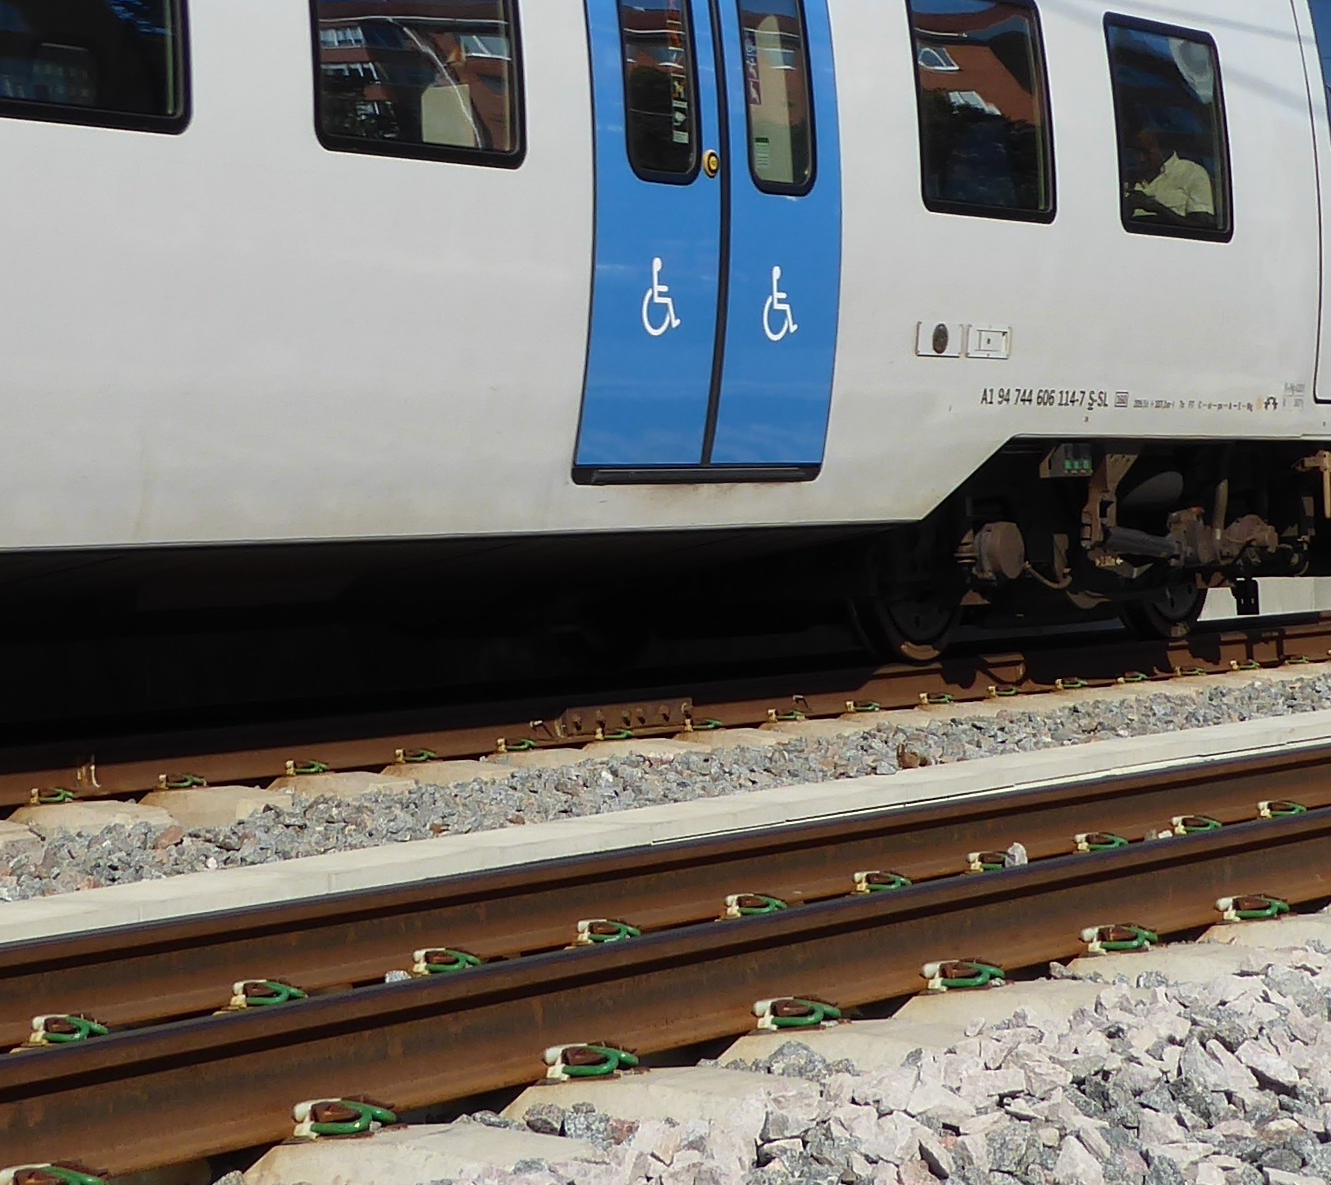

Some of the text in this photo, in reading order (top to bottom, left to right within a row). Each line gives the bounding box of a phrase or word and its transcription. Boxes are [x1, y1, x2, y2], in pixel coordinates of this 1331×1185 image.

[980, 387, 995, 405] A1
[997, 387, 1012, 405] 94
[1014, 388, 1033, 406] 744
[1036, 389, 1056, 407] 606
[1058, 390, 1086, 407] 114-7
